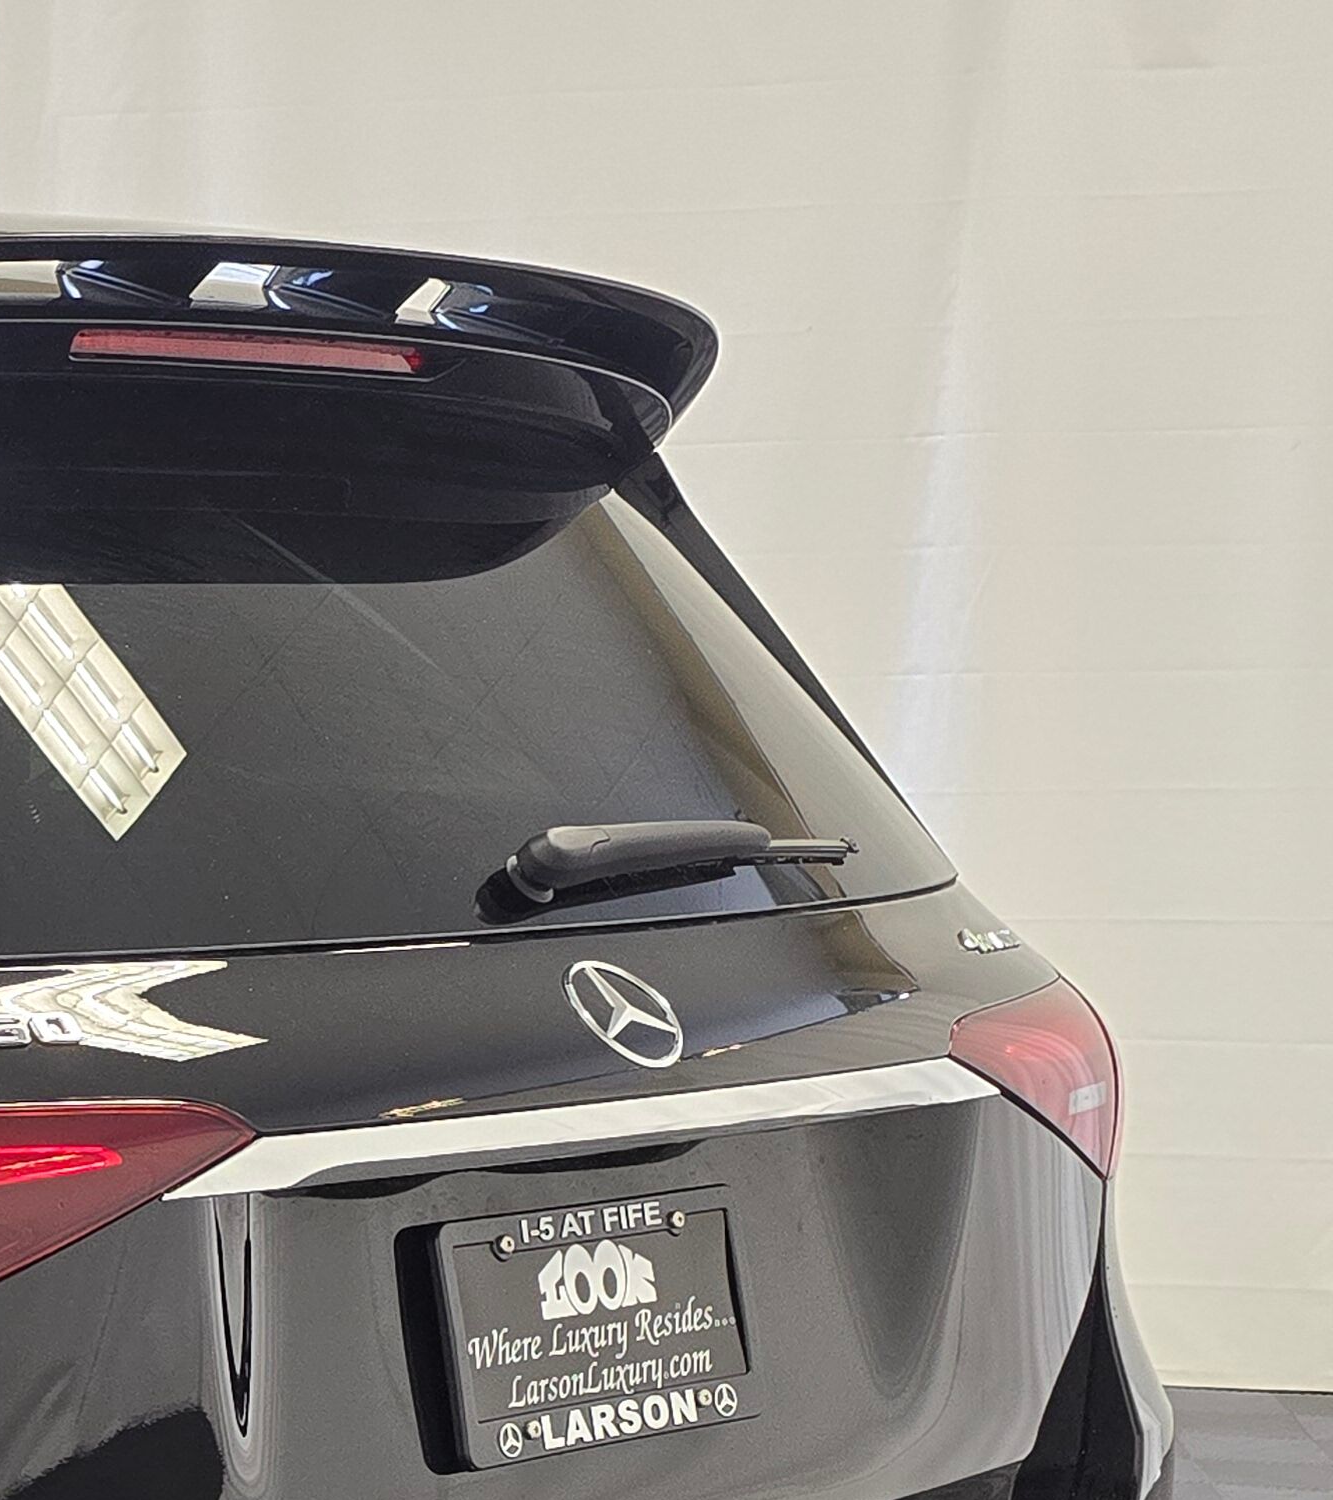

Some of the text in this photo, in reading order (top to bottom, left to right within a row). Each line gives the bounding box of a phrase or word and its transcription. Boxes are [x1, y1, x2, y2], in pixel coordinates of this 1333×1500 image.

[520, 1201, 663, 1244] I-5 AT FIFE
[538, 1239, 658, 1321] LOOK
[468, 1295, 737, 1370] Where Luxury Resides...
[508, 1349, 714, 1409] LarsonLuxury.com
[540, 1388, 699, 1451] LARSON
